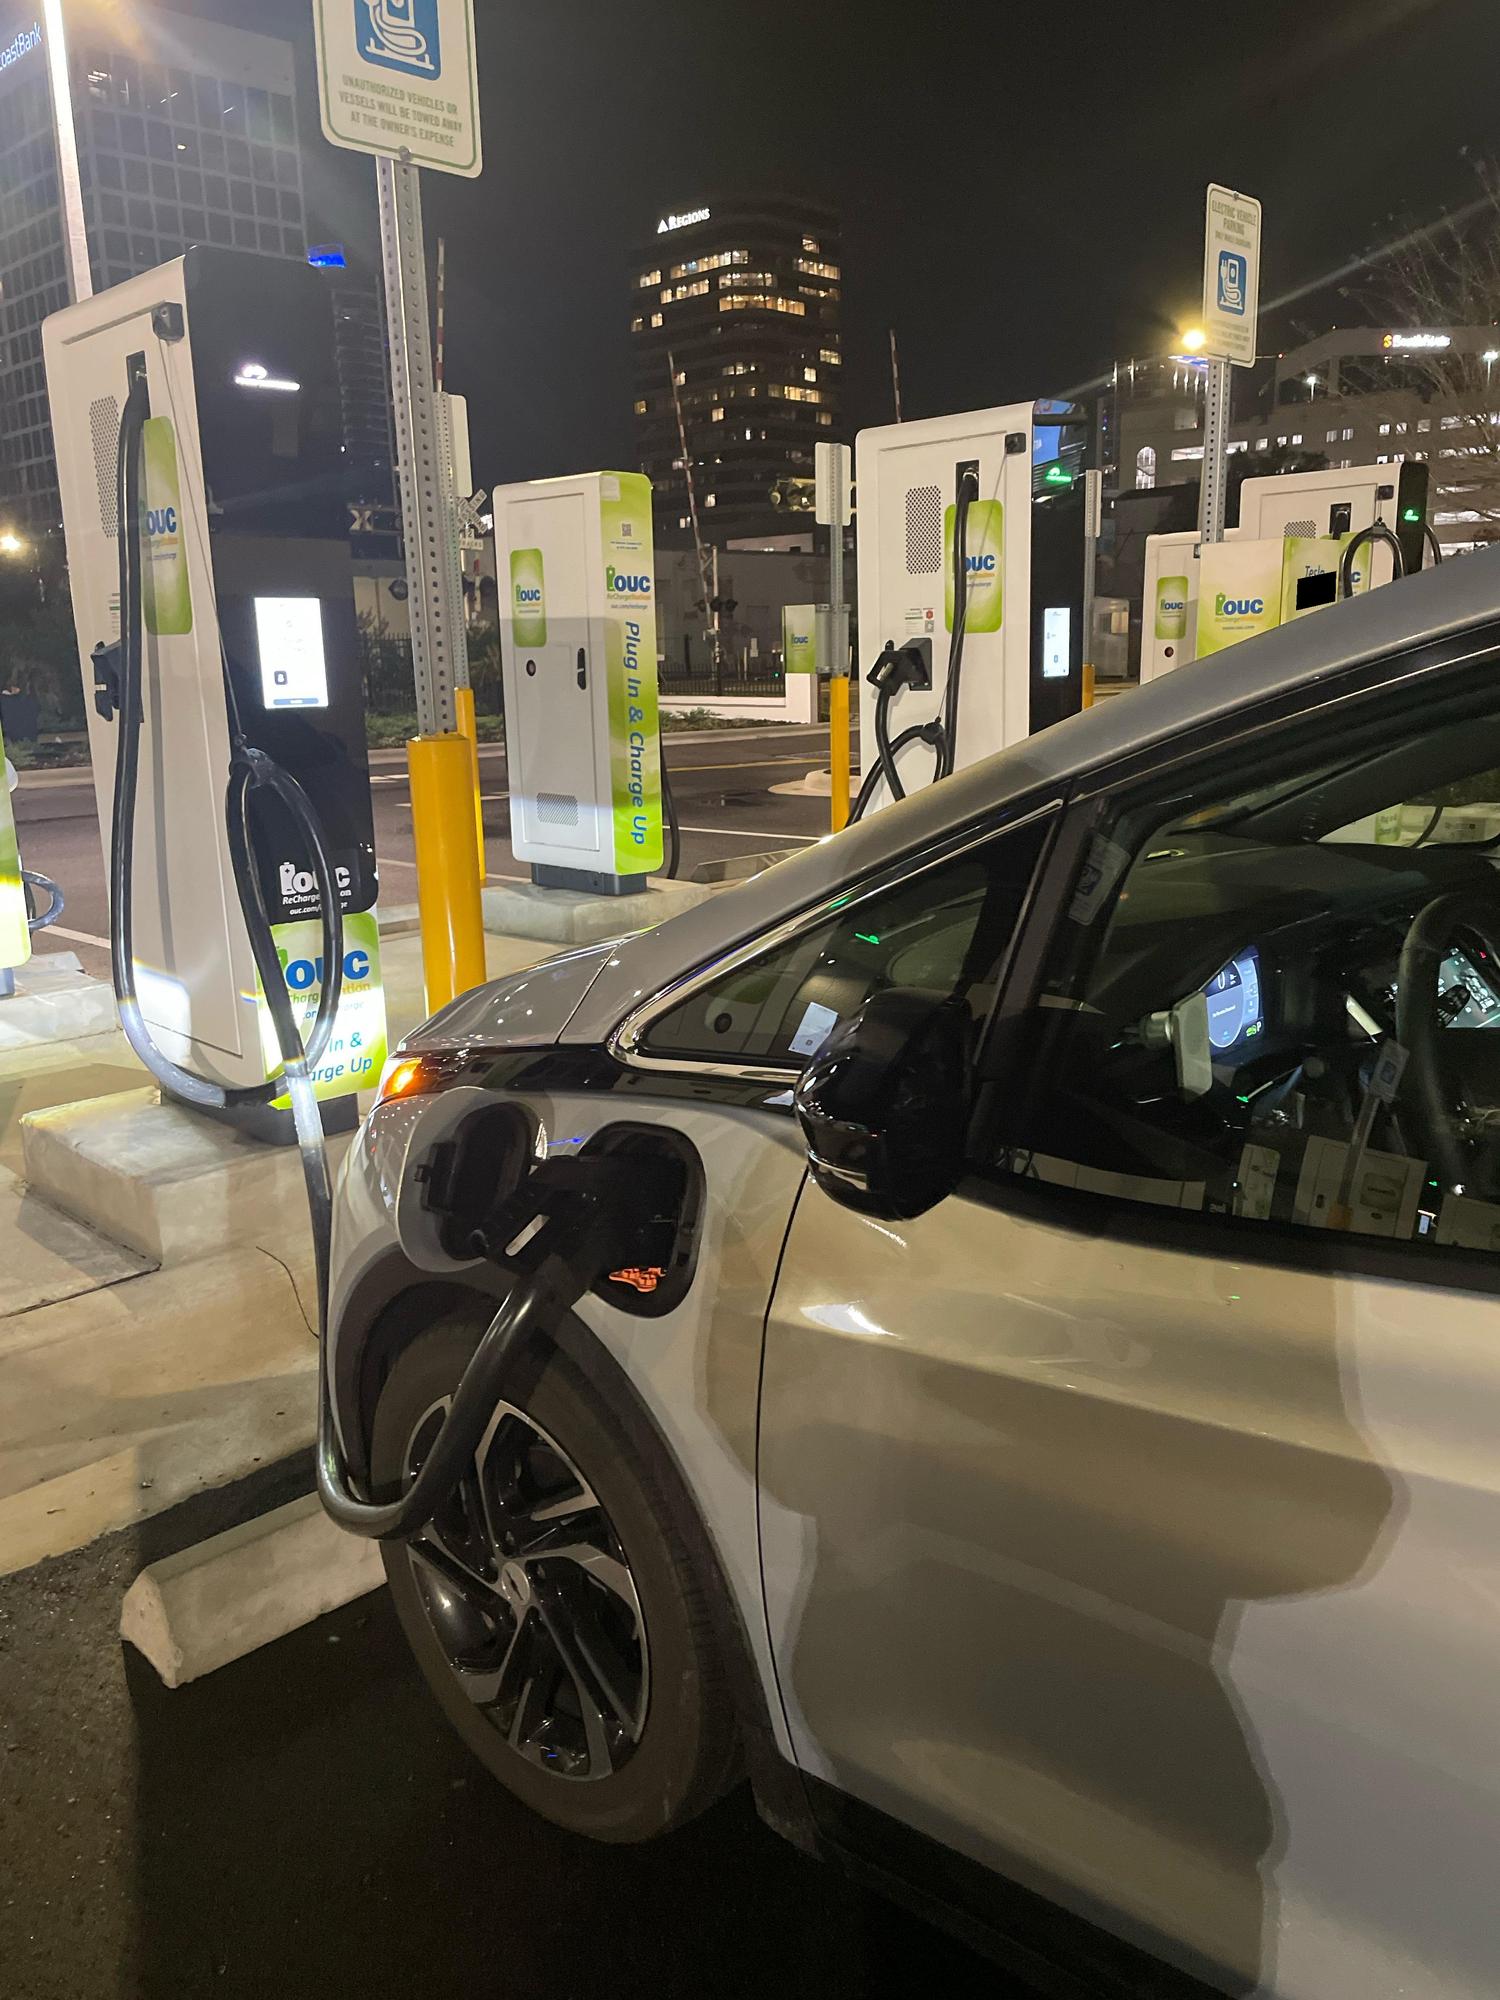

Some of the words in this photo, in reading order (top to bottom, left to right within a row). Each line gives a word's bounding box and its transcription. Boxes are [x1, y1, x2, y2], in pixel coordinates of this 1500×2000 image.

[342, 74, 405, 100] UNAUTHORIZED
[407, 91, 446, 113] VEHICLES
[446, 103, 458, 115] OR
[338, 91, 377, 110] VESSELS
[377, 99, 398, 116] WILL
[399, 104, 411, 120] BE
[411, 108, 440, 127] TOWED
[441, 117, 463, 134] AWAY
[350, 110, 362, 124] AT
[362, 112, 378, 128] THE
[380, 117, 418, 138] OWNER'S
[419, 127, 455, 148] EXPENSE
[624, 621, 640, 670] Plug
[628, 677, 642, 698] In
[629, 706, 643, 724] &
[628, 732, 645, 808] Charge
[633, 816, 648, 845] Up
[350, 1032, 362, 1048] &
[351, 1057, 372, 1074] Up
